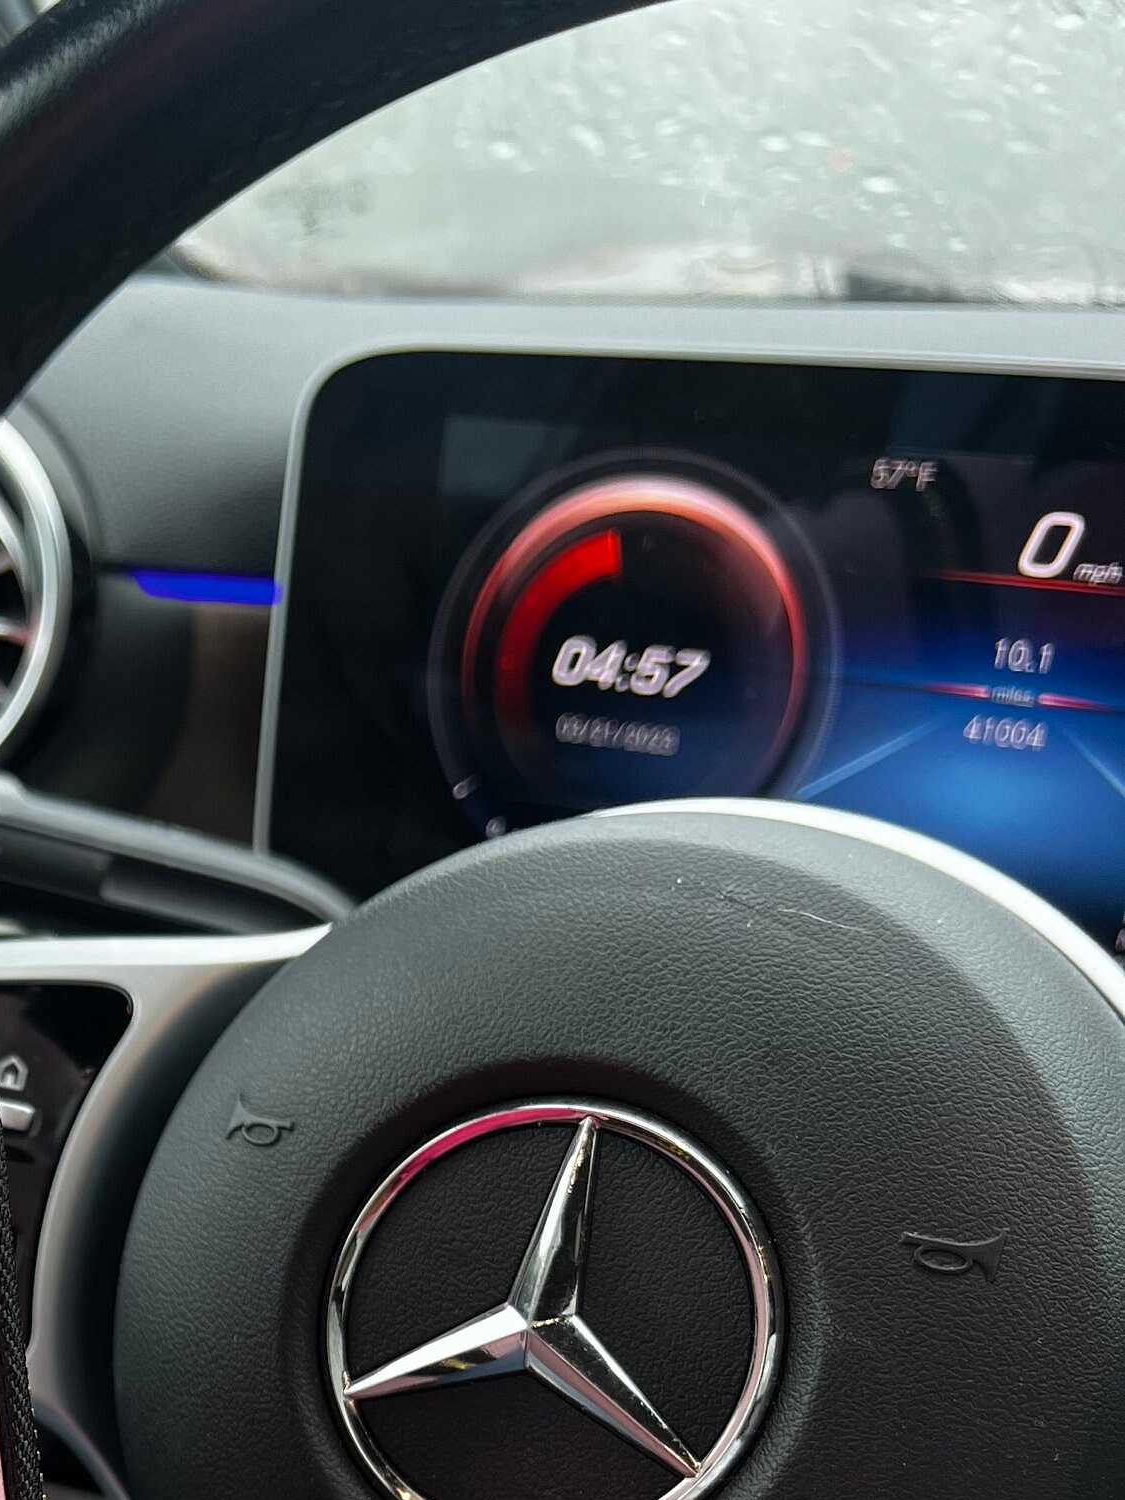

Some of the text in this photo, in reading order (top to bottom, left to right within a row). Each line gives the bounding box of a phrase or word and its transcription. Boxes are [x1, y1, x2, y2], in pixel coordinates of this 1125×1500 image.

[1018, 511, 1124, 587] 0 mph
[552, 635, 712, 699] 04:57
[994, 637, 1055, 675] 10.1
[963, 714, 1049, 751] 41004
